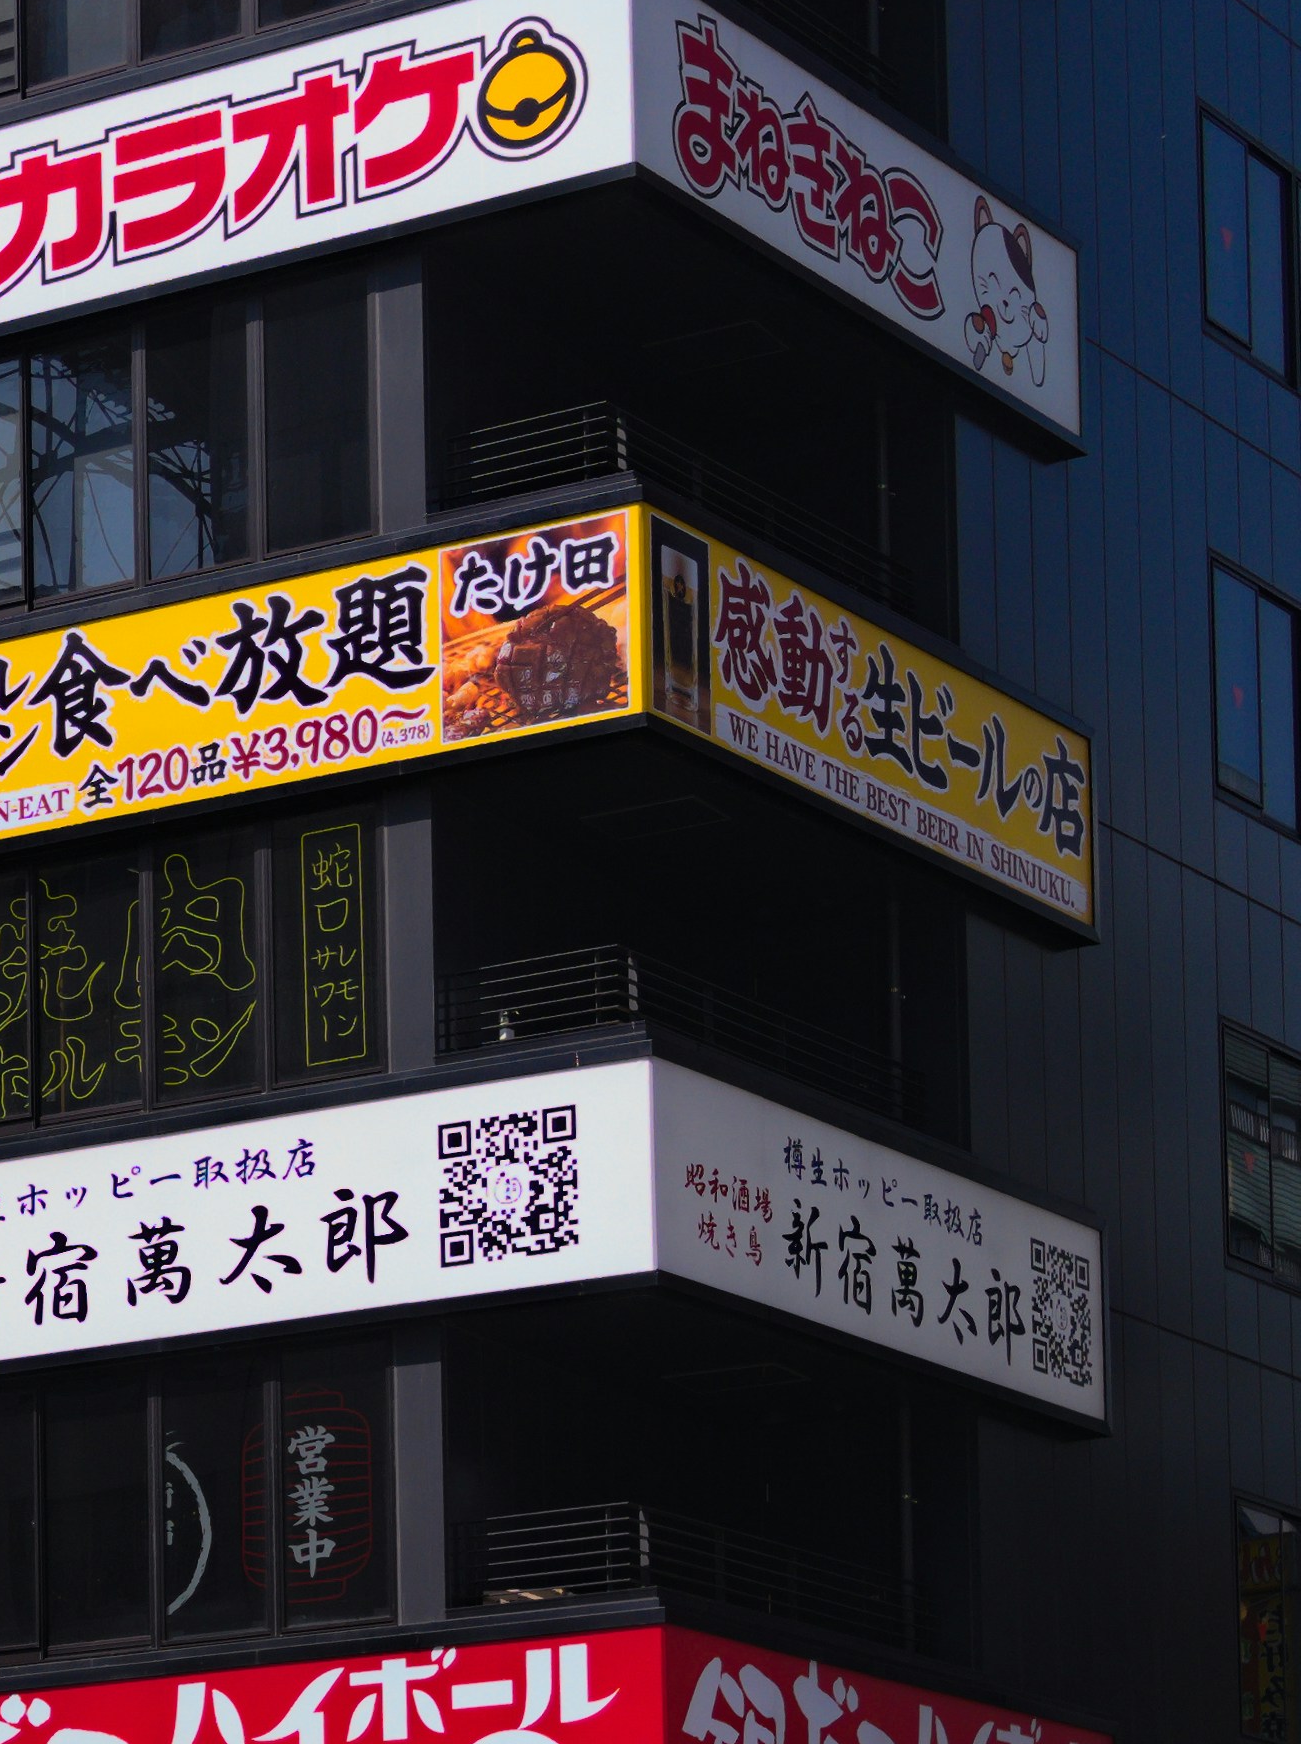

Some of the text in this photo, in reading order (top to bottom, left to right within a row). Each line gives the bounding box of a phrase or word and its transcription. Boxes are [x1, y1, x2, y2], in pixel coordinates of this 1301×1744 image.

[675, 16, 945, 322] まねきねこ
[449, 534, 621, 617] たけ田
[29, 568, 435, 756] 食べ放題
[715, 560, 1086, 856] 感動する生ビールの店
[310, 842, 354, 932] 蛇口
[728, 712, 1076, 909] WE HAVE THE BEST BEER IN SHINJUKU.
[684, 1163, 774, 1223] 昭和酒場
[697, 1210, 763, 1268] 焼き鳥
[781, 1198, 1026, 1366] 新宿萬太郎
[286, 1424, 336, 1580] 営業中
